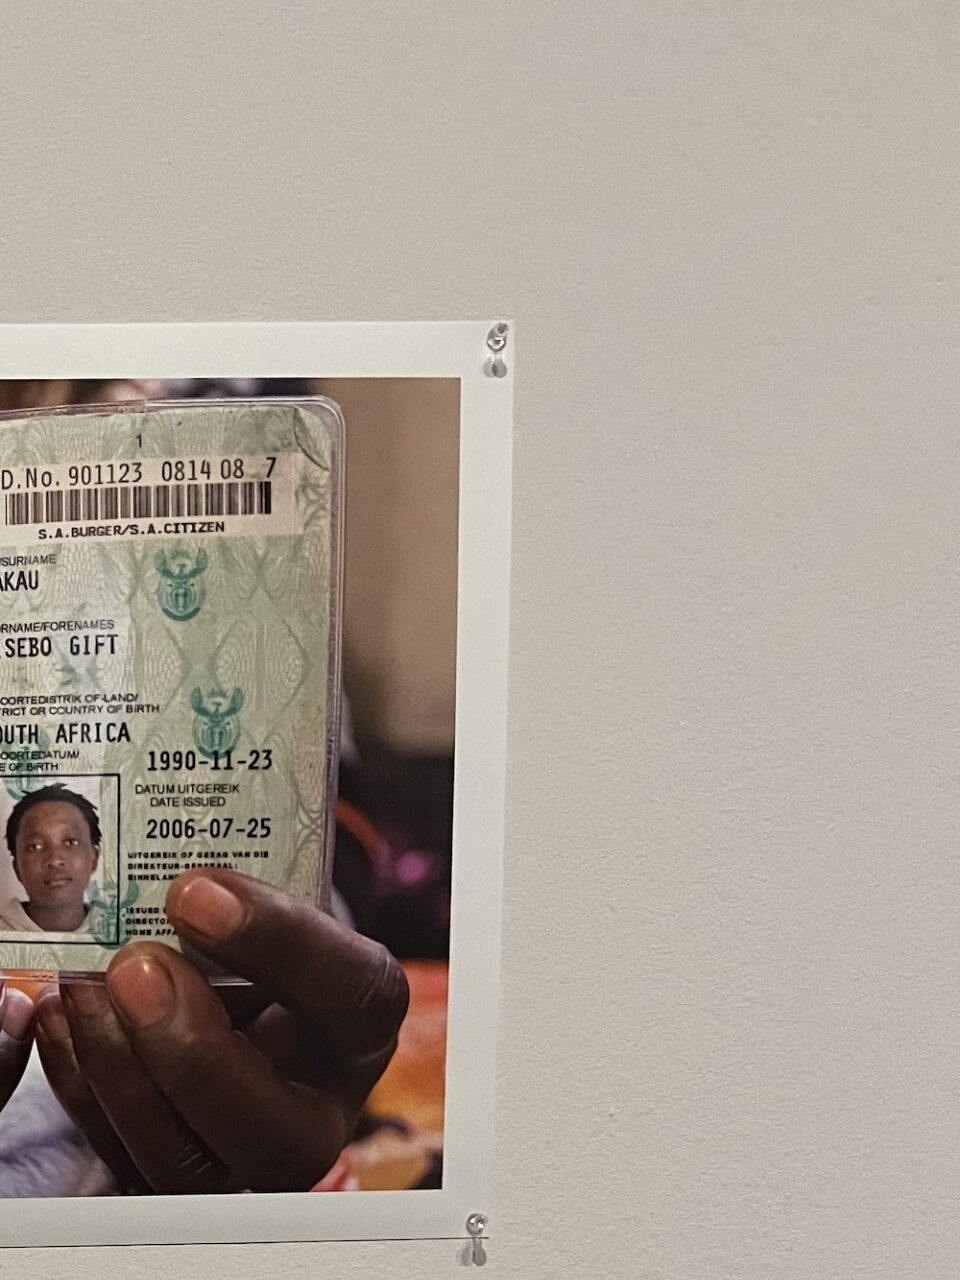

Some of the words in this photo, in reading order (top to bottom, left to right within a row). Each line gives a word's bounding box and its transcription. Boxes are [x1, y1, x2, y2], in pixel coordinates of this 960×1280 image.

[136, 434, 142, 448] 1
[68, 463, 142, 486] 901123
[161, 460, 212, 482] 0814
[221, 458, 244, 479] 08
[266, 458, 277, 478] 7
[38, 521, 225, 540] S.A.BURGER/S.A.CITIZEN
[70, 634, 119, 656] GIFT
[30, 706, 46, 716] OR
[49, 705, 104, 714] COUNTRY
[107, 704, 123, 714] OF
[126, 704, 160, 713] BIRTH
[55, 722, 131, 743] AFRICA
[8, 762, 23, 771] OF
[26, 761, 59, 771] BIRTH
[147, 749, 273, 771] 1990-11-23
[135, 784, 176, 794] DATUM
[178, 784, 240, 794] UITGEREIK
[150, 797, 180, 807] DATE
[183, 796, 226, 807] ISSUED
[146, 818, 272, 840] 2006-07-25
